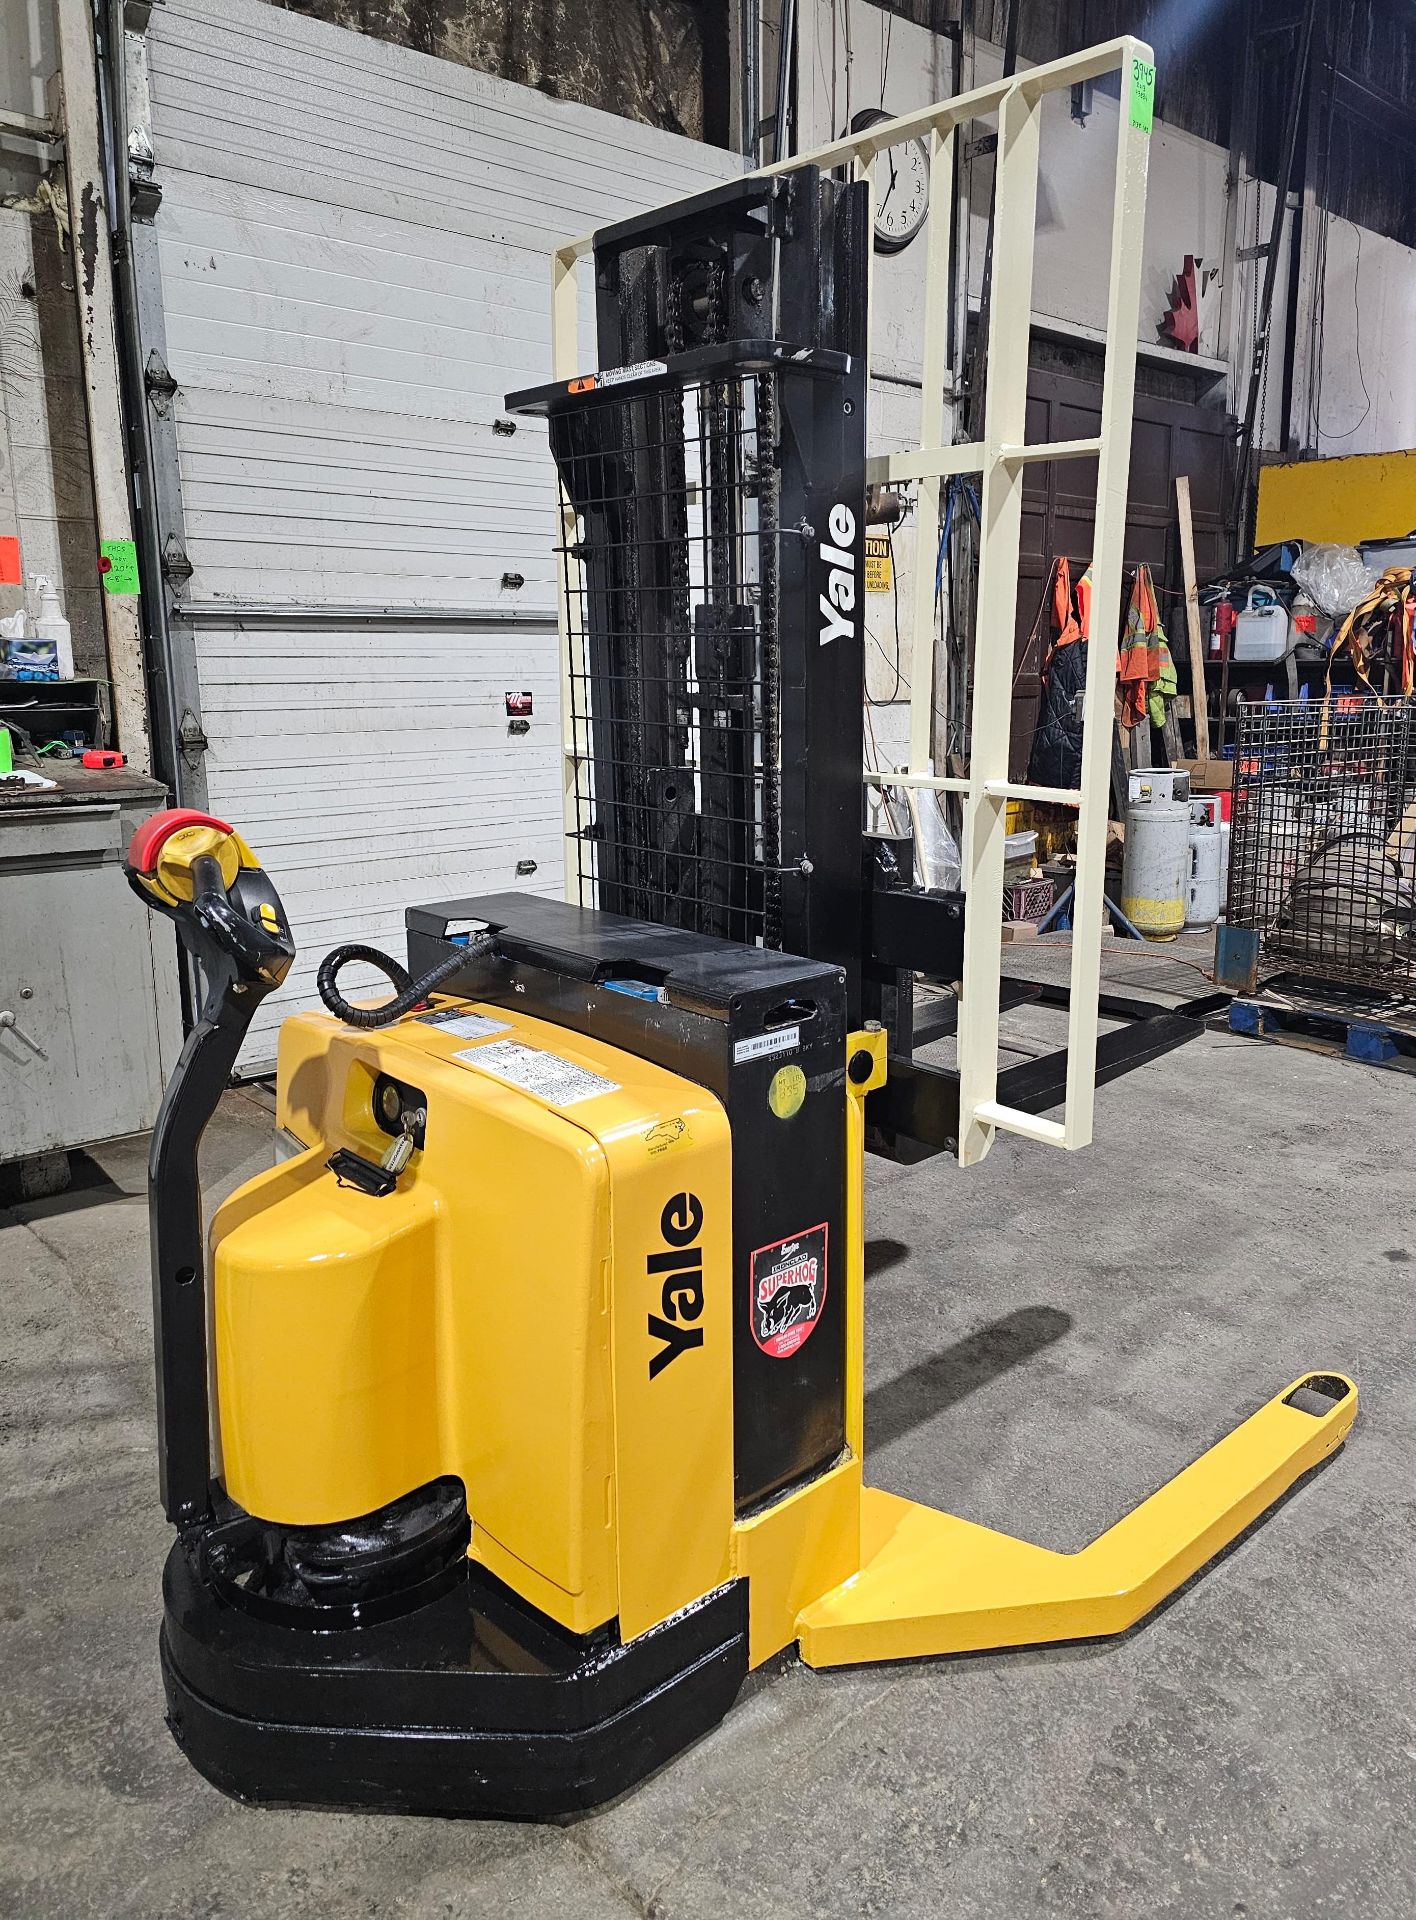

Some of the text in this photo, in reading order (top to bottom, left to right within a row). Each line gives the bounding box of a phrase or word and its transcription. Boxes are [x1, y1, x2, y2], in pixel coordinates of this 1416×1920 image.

[1132, 59, 1154, 86] 3945
[910, 158, 917, 171] 2
[914, 180, 921, 194] 3
[876, 203, 882, 217] 7
[909, 199, 916, 212] 4
[886, 212, 894, 226] 6
[900, 210, 907, 225] 5
[605, 368, 622, 377] MOVING
[865, 540, 887, 556] TION
[876, 560, 882, 569] BE
[820, 503, 856, 647] Yale
[866, 570, 882, 579] BEFORE
[772, 1253, 808, 1273] IRONCLAD
[647, 1192, 704, 1381] Yale
[760, 1259, 816, 1300] SUPERHOG
